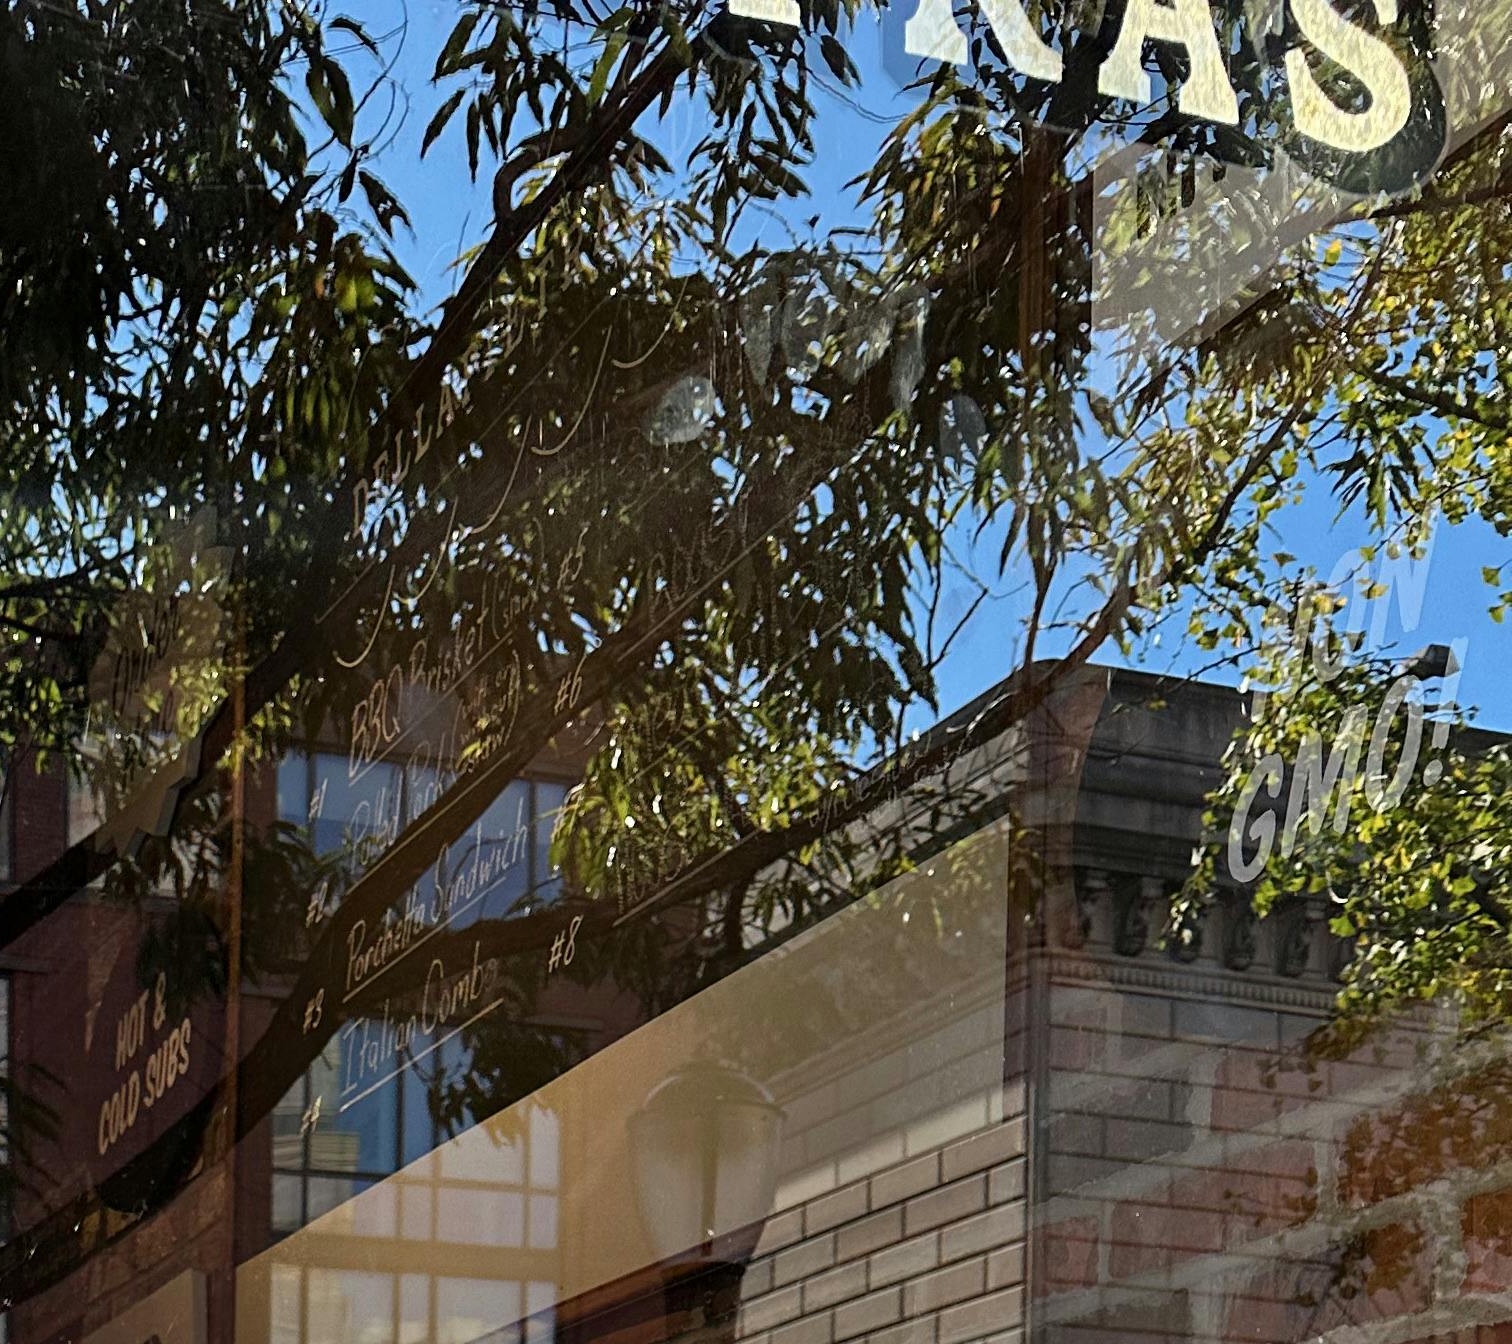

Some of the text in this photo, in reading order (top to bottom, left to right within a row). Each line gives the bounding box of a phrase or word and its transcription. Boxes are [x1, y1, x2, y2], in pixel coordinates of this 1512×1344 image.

[1229, 637, 1469, 882] GMO!
[548, 914, 583, 973] #8
[115, 971, 168, 1072] HOT &
[99, 1018, 191, 1156] COLD SUBS
